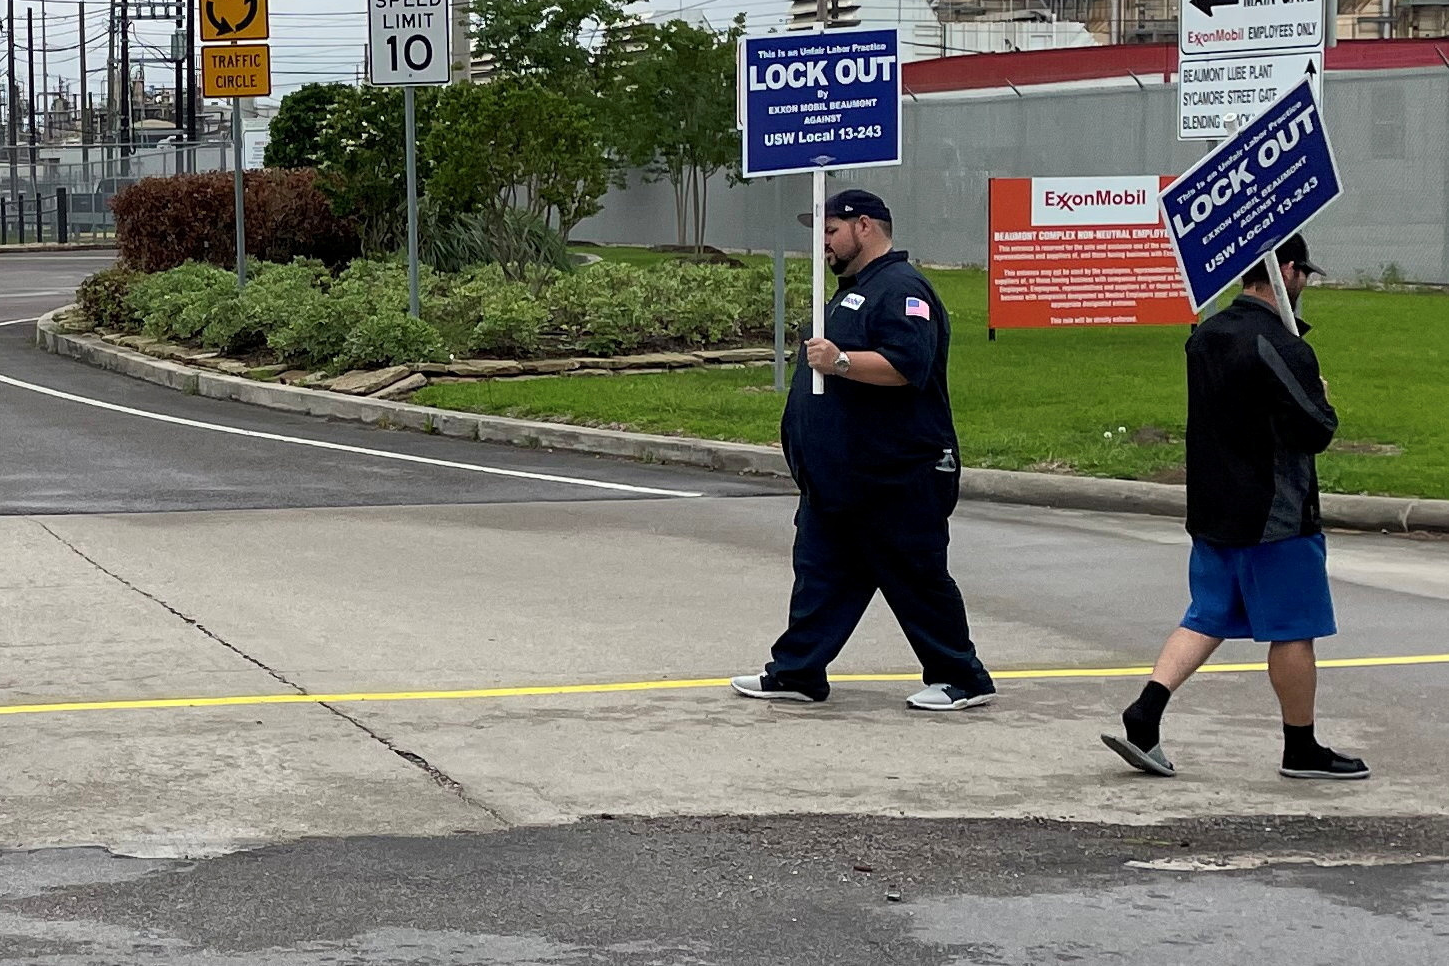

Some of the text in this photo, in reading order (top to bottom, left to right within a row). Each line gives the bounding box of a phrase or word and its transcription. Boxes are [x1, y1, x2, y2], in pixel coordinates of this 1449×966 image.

[383, 13, 434, 30] LIMIT
[1187, 22, 1317, 47] ExxonMobil EMPLOYEES ONLY
[386, 34, 433, 71] 10
[758, 50, 776, 59] This
[800, 46, 825, 56] Unfair
[827, 45, 850, 54] Labor
[852, 43, 886, 52] Practice
[211, 53, 262, 69] TRAFFIC
[215, 74, 258, 89] CIRCLE
[749, 55, 896, 91] LOCK OUT
[1183, 64, 1273, 83] BEAUMONT LUBE PLANT
[817, 90, 829, 100] By
[1183, 90, 1224, 106] SYCAMORE
[1227, 88, 1256, 104] STREET
[768, 98, 877, 114] EXXON MOBIL BEAUMONT
[804, 114, 842, 125] AGAINST
[1182, 114, 1220, 129] BLENDING
[765, 125, 881, 146] USW Local 13-243
[1177, 189, 1196, 204] This
[1206, 171, 1218, 182] an
[1218, 149, 1243, 172] Unfair
[1244, 129, 1267, 151] Labor
[1268, 101, 1302, 131] Practice
[1172, 104, 1315, 239] LOCK OUT
[1246, 184, 1257, 196] By
[1045, 189, 1146, 212] ExxonMobil
[1202, 156, 1307, 245] EXXON MOBIL BEAUMONT
[1240, 194, 1276, 228] AGAINST
[1205, 176, 1318, 273] USW Local 13-243
[994, 231, 1037, 241] BEAUMONT
[1038, 230, 1076, 240] COMPLEX
[1077, 229, 1131, 240] NON-NEUTRAL
